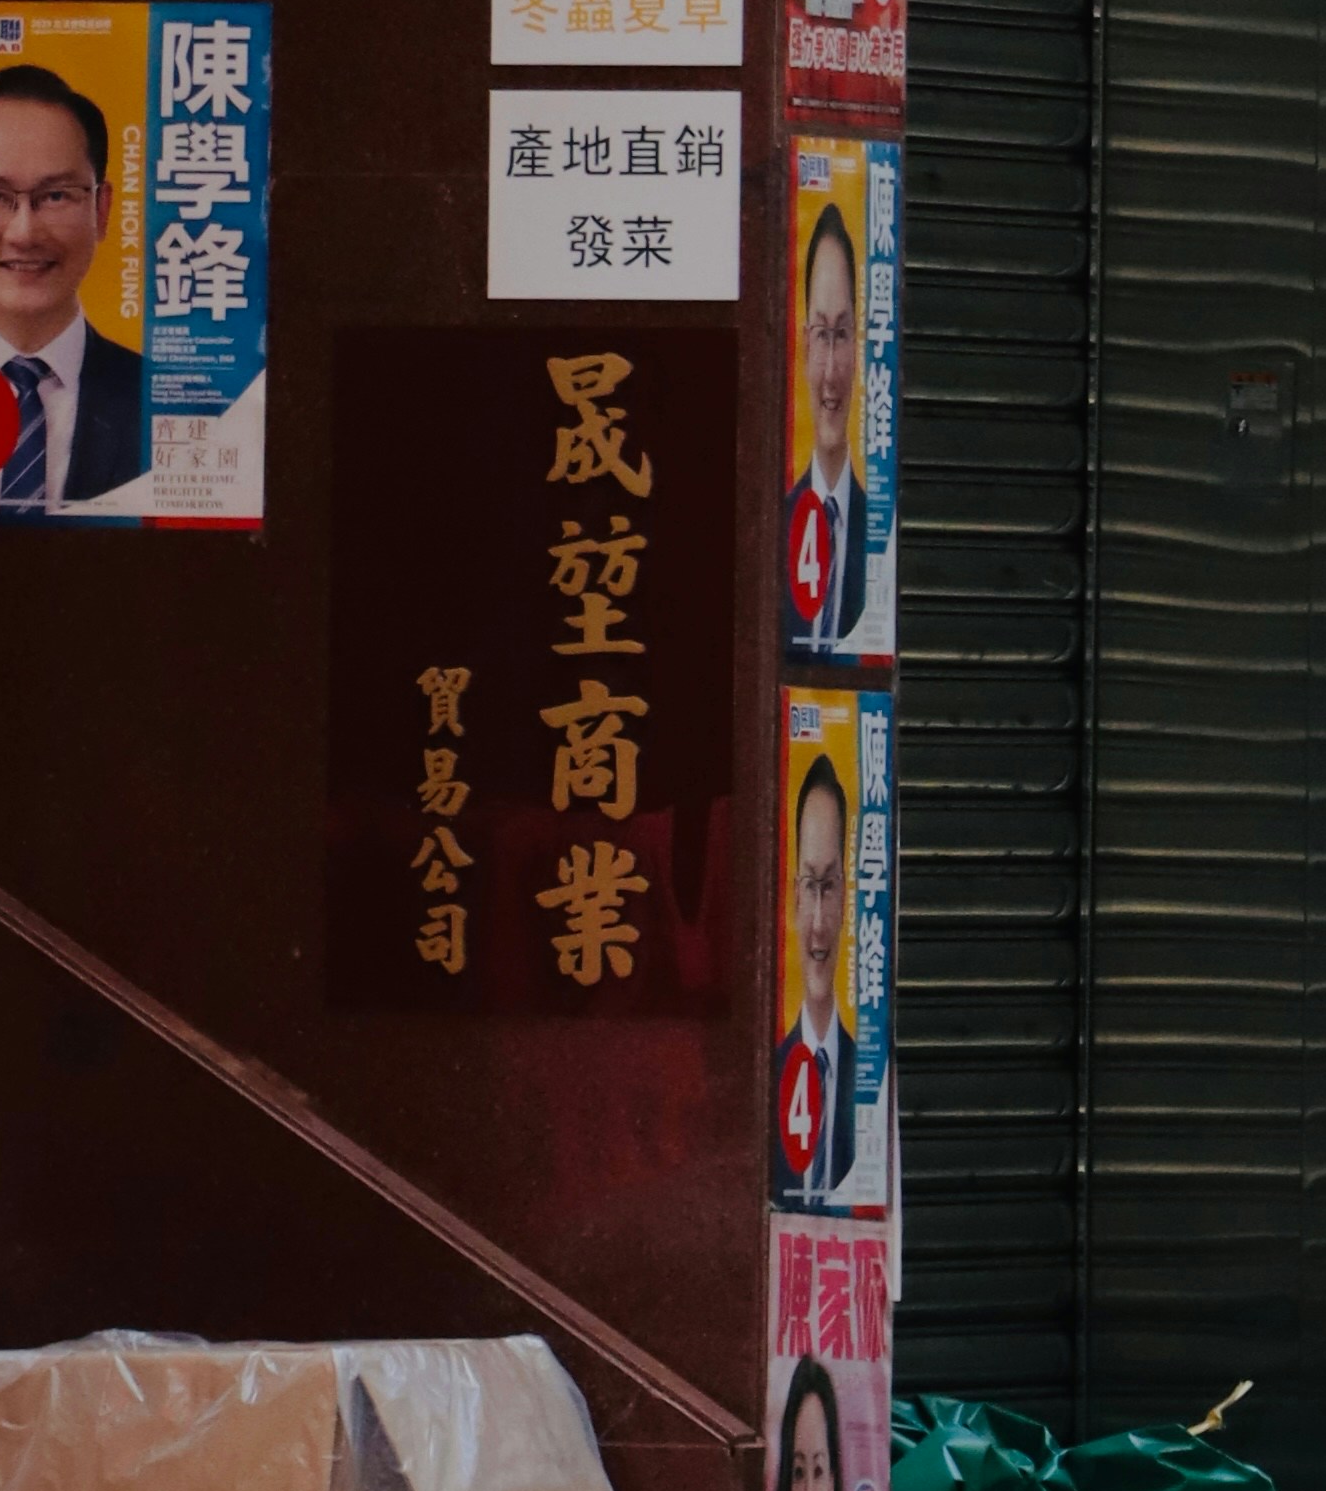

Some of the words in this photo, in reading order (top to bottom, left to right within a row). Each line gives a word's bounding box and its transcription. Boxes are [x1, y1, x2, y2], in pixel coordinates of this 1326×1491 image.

[121, 125, 141, 192] CHAN
[154, 20, 252, 321] 陳學鋒
[506, 126, 726, 179] 產地直銷
[121, 196, 140, 250] HOK
[567, 215, 675, 270] 發菜
[119, 254, 140, 320] FUNG
[798, 509, 821, 600] 4
[410, 666, 474, 975] 貿易公司
[788, 1060, 812, 1151] 4
